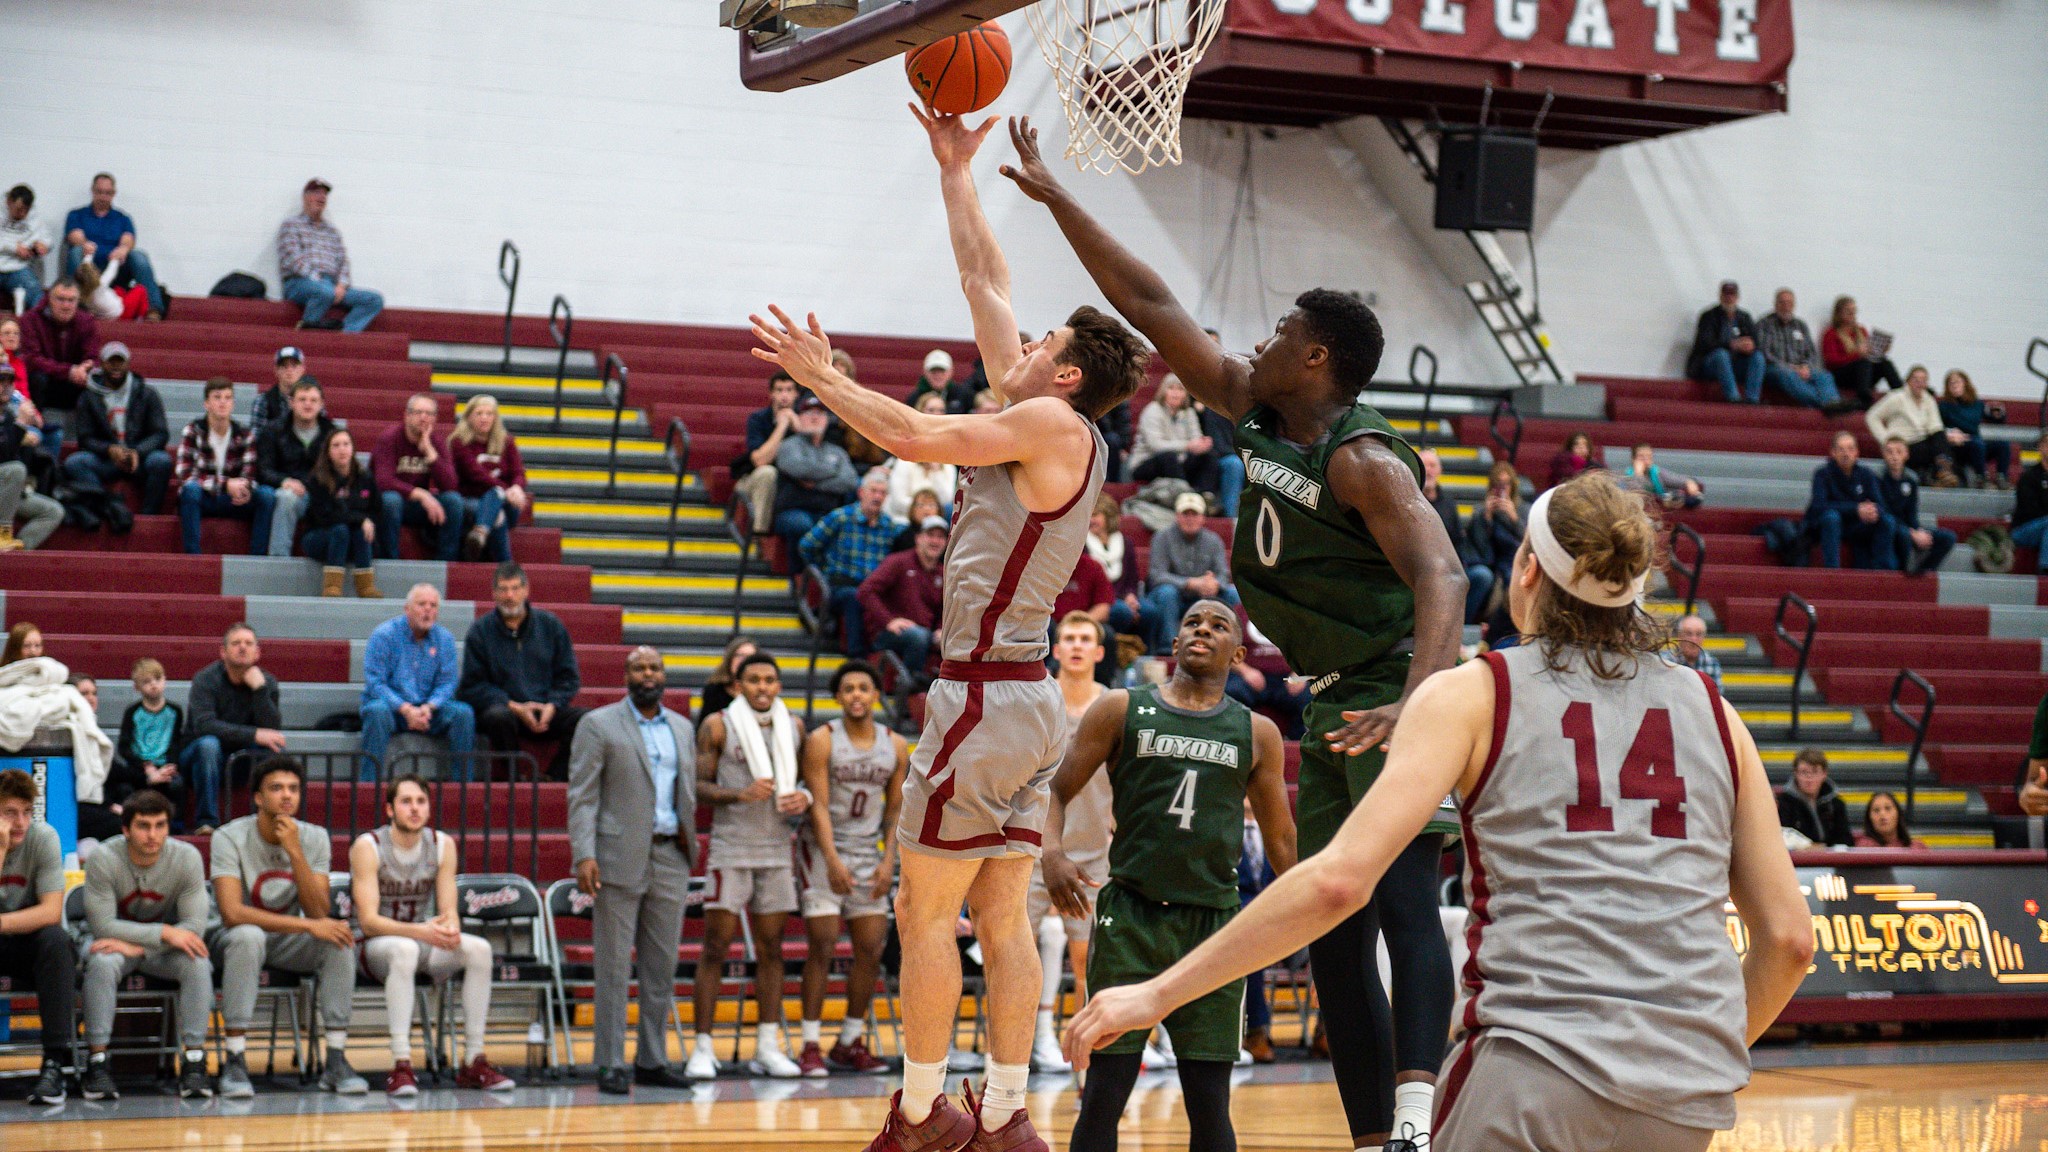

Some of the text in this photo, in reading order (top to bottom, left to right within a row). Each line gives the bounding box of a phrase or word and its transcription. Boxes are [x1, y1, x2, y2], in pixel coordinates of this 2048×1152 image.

[1271, 0, 1761, 61] LGATE
[1238, 447, 1322, 510] LOYOLA
[1255, 497, 1282, 568] 0
[1137, 729, 1239, 769] LOYOLA
[1561, 701, 1687, 839] 14
[851, 790, 868, 818] 0
[1167, 768, 1198, 830] 4
